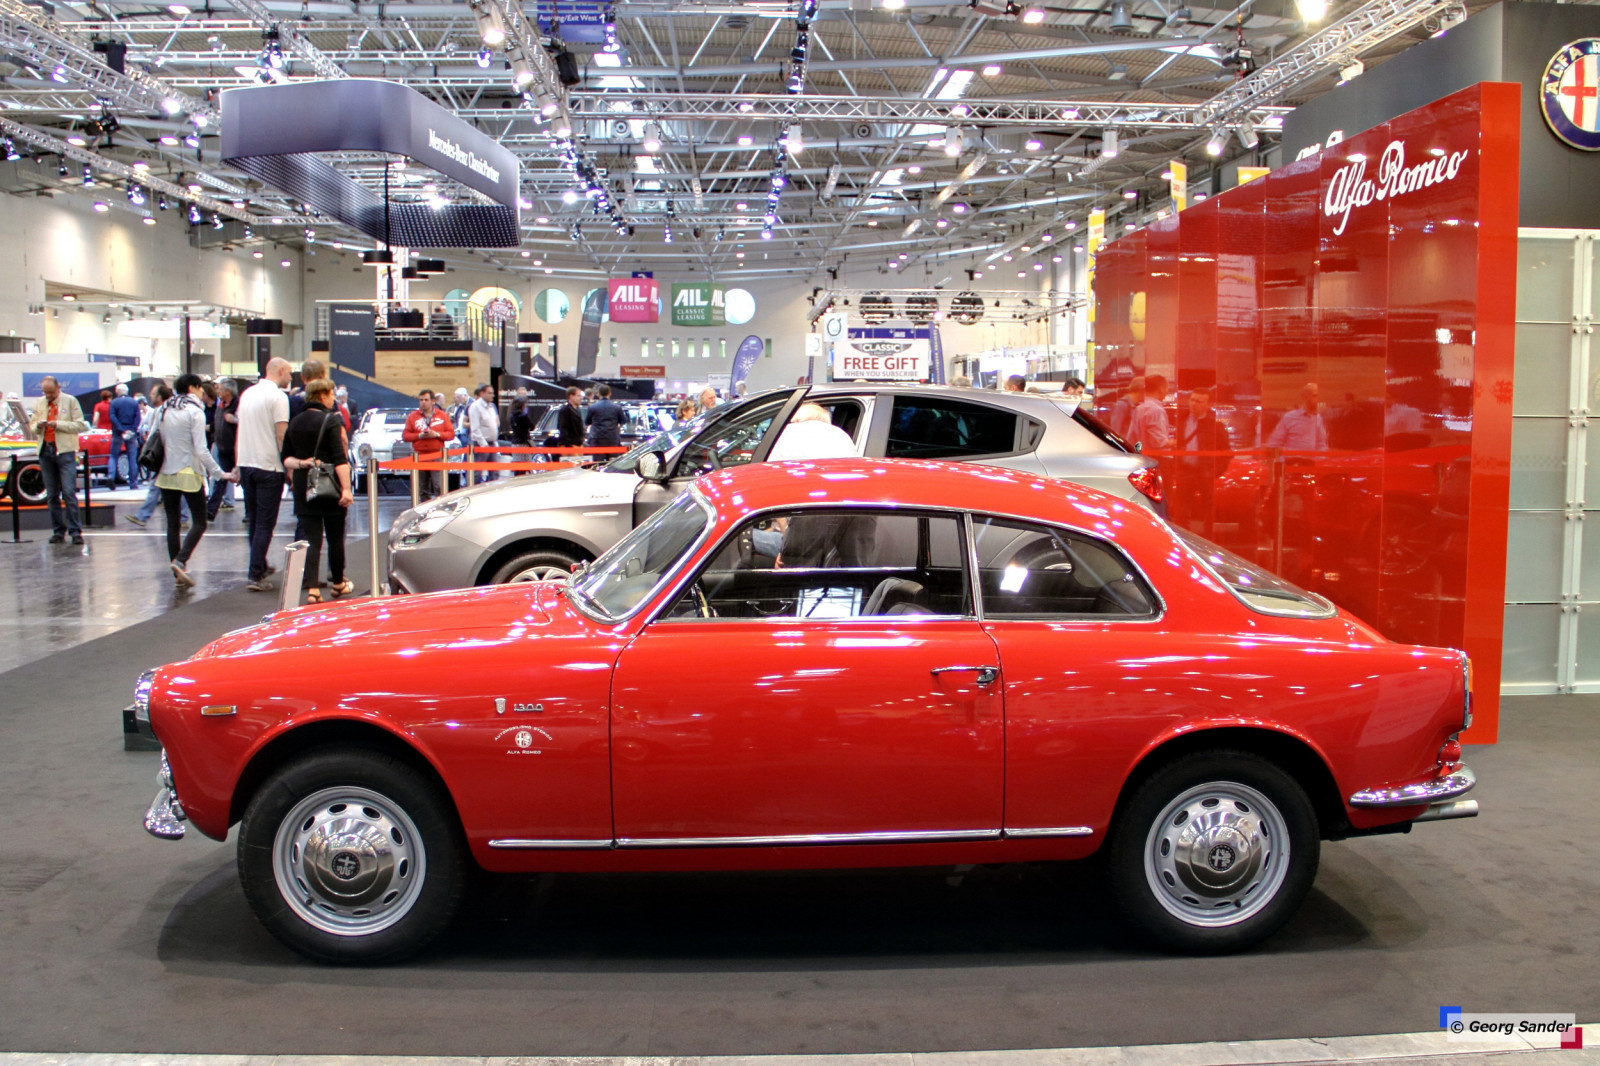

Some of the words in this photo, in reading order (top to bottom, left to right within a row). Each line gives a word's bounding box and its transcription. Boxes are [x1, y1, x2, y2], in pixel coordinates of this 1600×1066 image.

[539, 14, 579, 23] Ausang/Exit
[1545, 46, 1584, 96] ALFA
[1324, 160, 1375, 236] Alfa
[1375, 140, 1468, 201] Romeo
[611, 285, 648, 303] AIL
[673, 288, 709, 307] AIL
[711, 289, 725, 308] AIL
[862, 343, 901, 352] CLASSIC
[844, 357, 879, 370] FREE
[884, 357, 920, 370] GIFT
[513, 703, 544, 712] 1300
